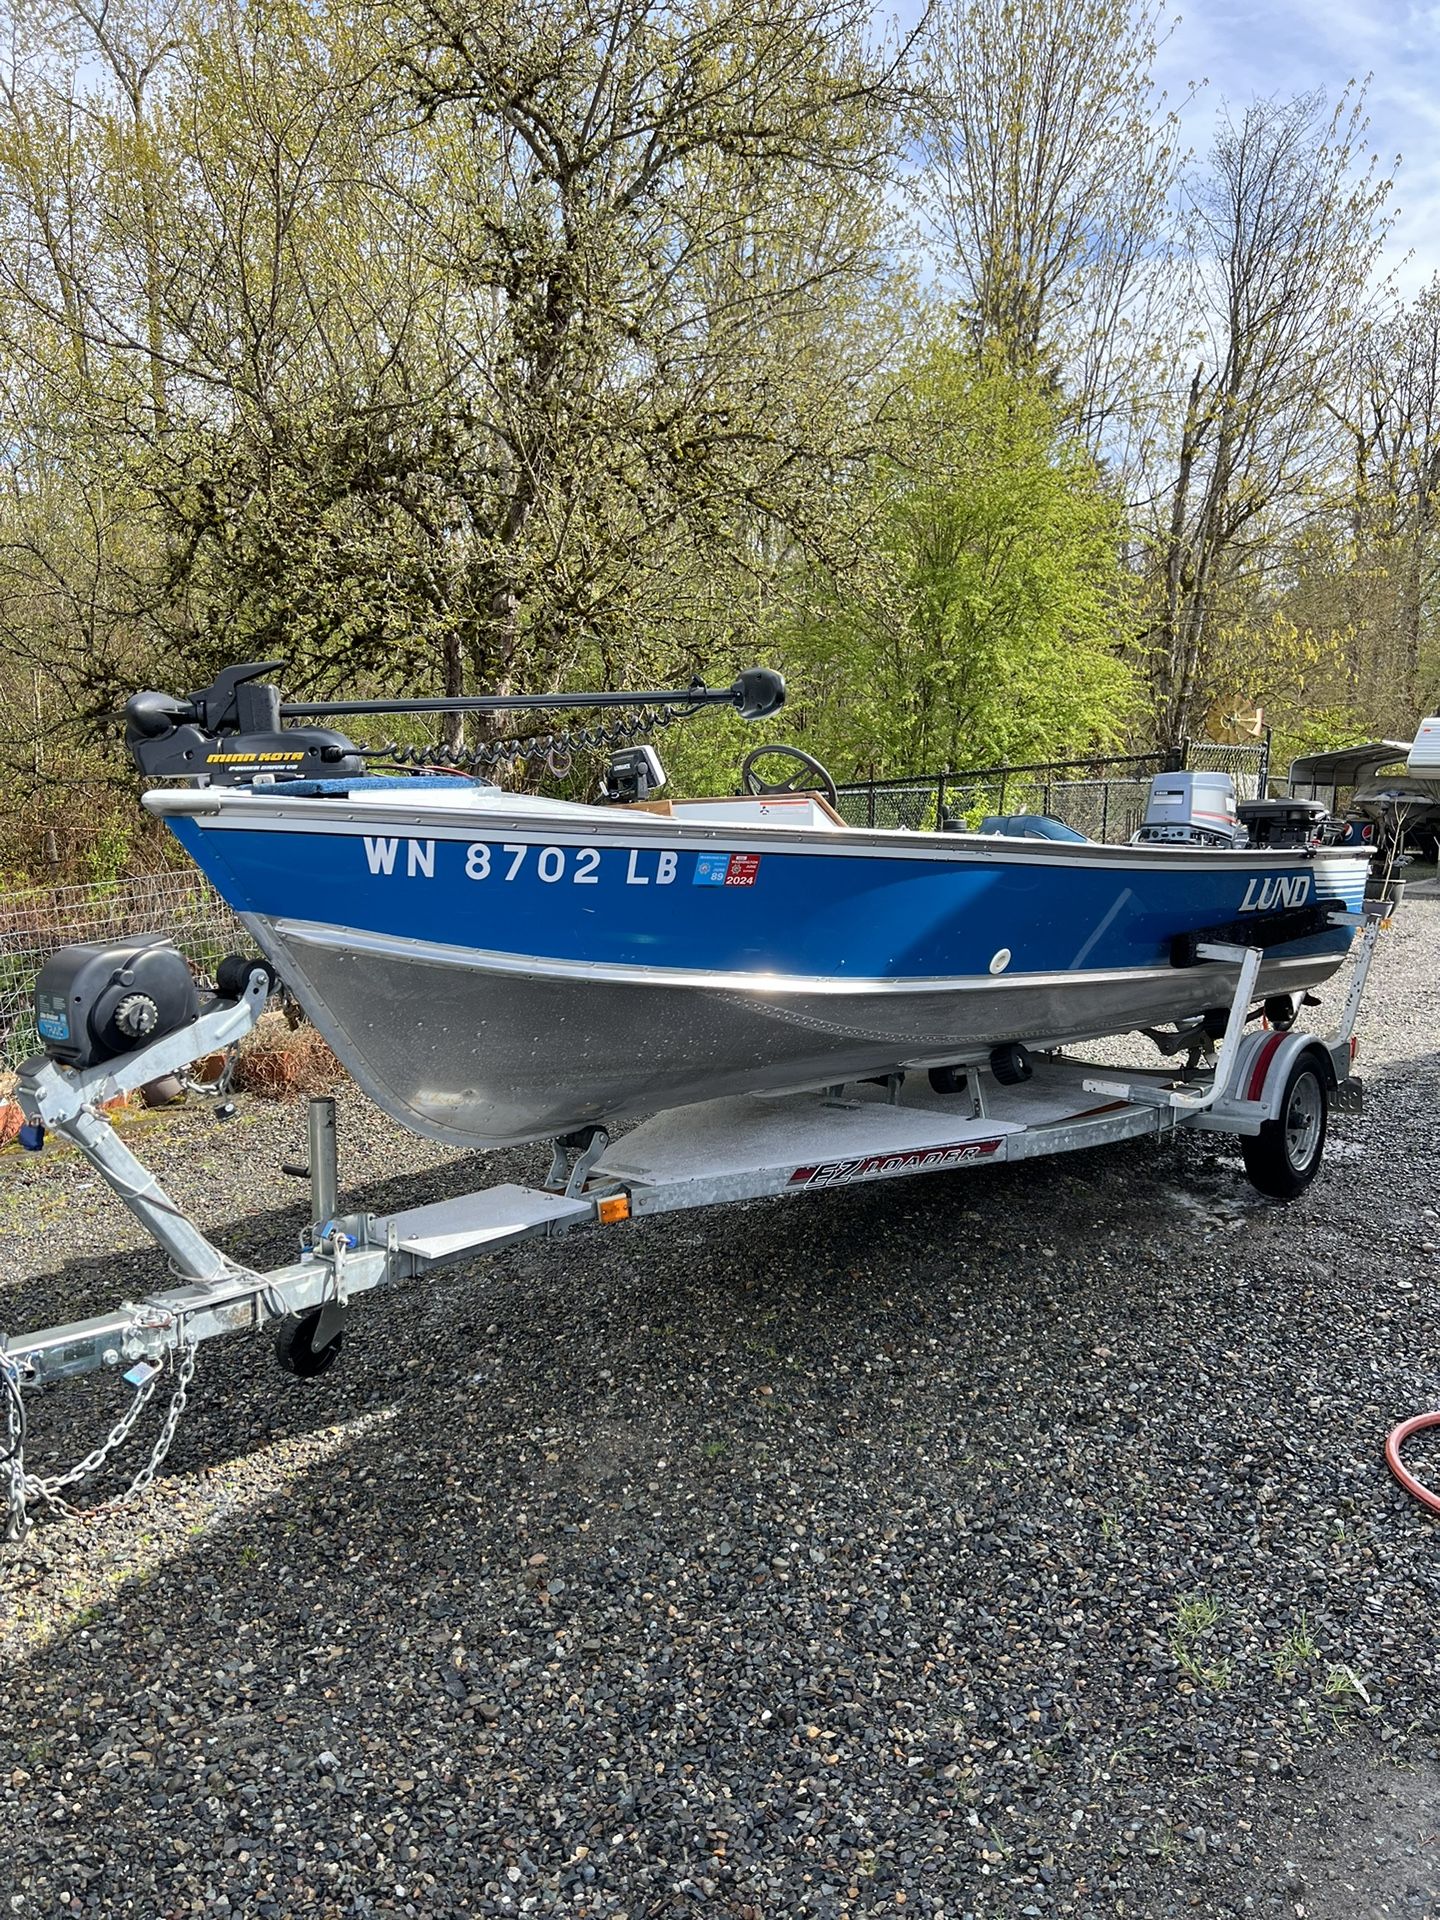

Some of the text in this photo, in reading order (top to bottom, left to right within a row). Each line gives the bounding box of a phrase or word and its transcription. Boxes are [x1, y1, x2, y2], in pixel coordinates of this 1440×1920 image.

[206, 752, 305, 763] MINN KOTA
[363, 837, 678, 885] WN 8702 LB
[710, 872, 724, 881] 89
[725, 876, 754, 885] 2024
[1239, 876, 1310, 910] LUND
[804, 1147, 981, 1190] EZ LOADER
